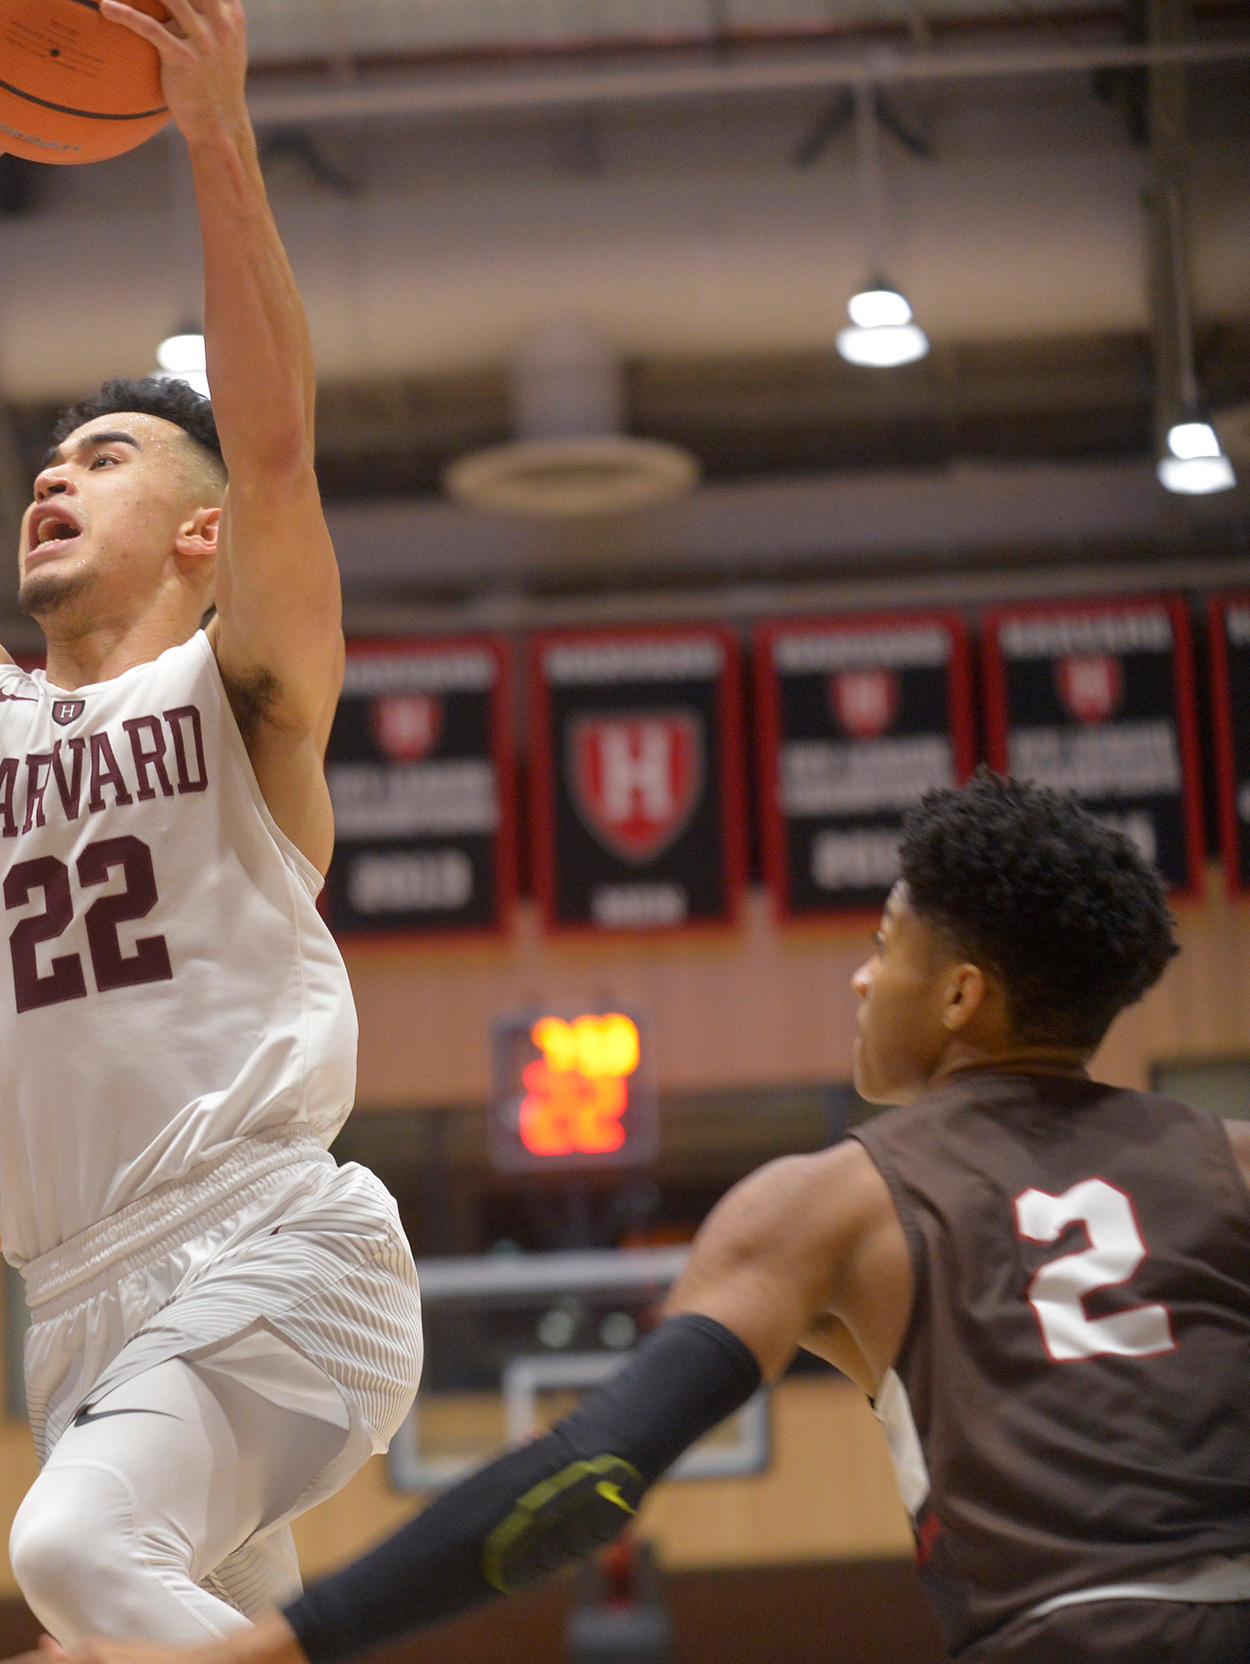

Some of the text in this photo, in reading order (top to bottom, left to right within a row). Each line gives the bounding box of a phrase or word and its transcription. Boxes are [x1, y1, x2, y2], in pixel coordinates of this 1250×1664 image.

[60, 704, 75, 718] H
[3, 835, 173, 1014] 22
[1014, 1176, 1177, 1361] 2
